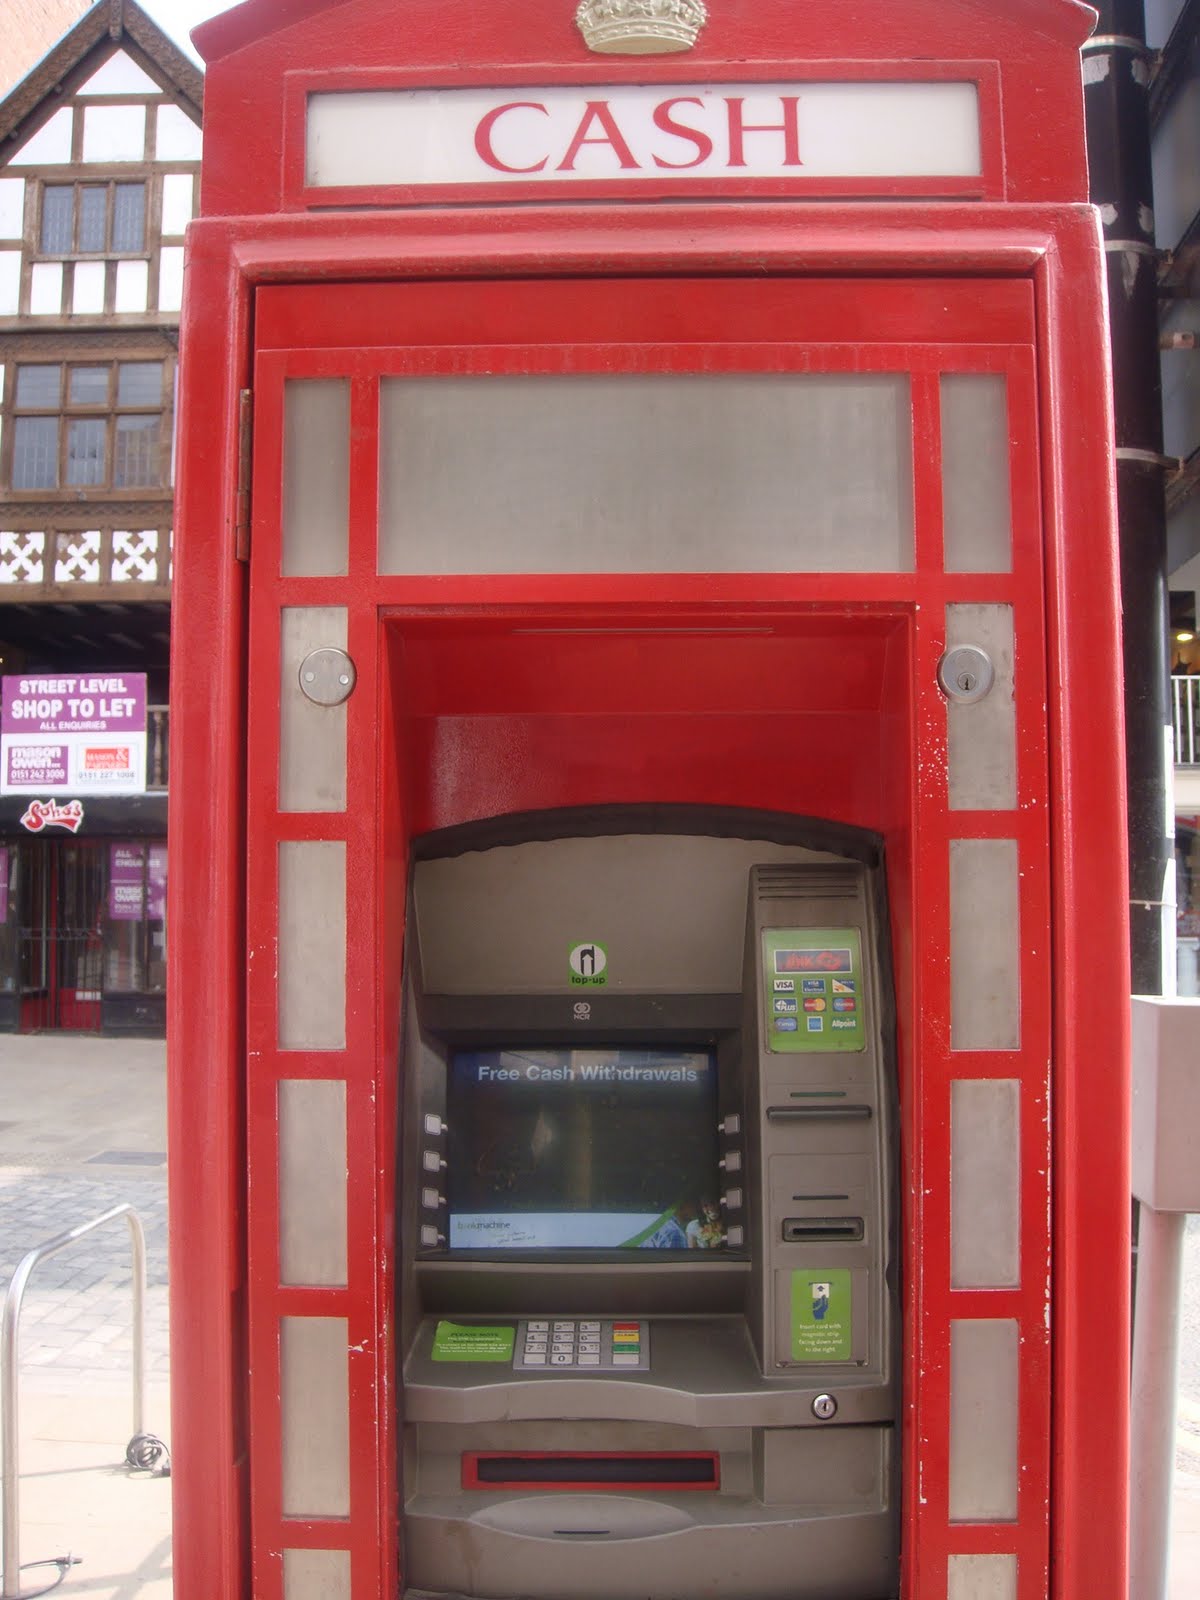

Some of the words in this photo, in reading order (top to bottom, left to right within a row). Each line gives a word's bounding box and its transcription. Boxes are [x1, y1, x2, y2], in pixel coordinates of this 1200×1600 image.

[473, 96, 805, 174] CASH
[20, 679, 77, 695] STREET
[80, 678, 127, 694] LEVEL
[11, 699, 63, 719] SHOP
[67, 698, 95, 718] TO
[99, 698, 136, 718] LET
[40, 722, 57, 730] ALL
[59, 720, 107, 730] ENQUIRIES
[11, 769, 29, 780] 0151
[571, 975, 606, 985] top-up
[775, 981, 794, 989] VISA
[832, 1019, 856, 1028] Allpoint
[478, 1066, 519, 1081] Free
[526, 1066, 574, 1081] Cash
[580, 1065, 697, 1082] Withdrawals
